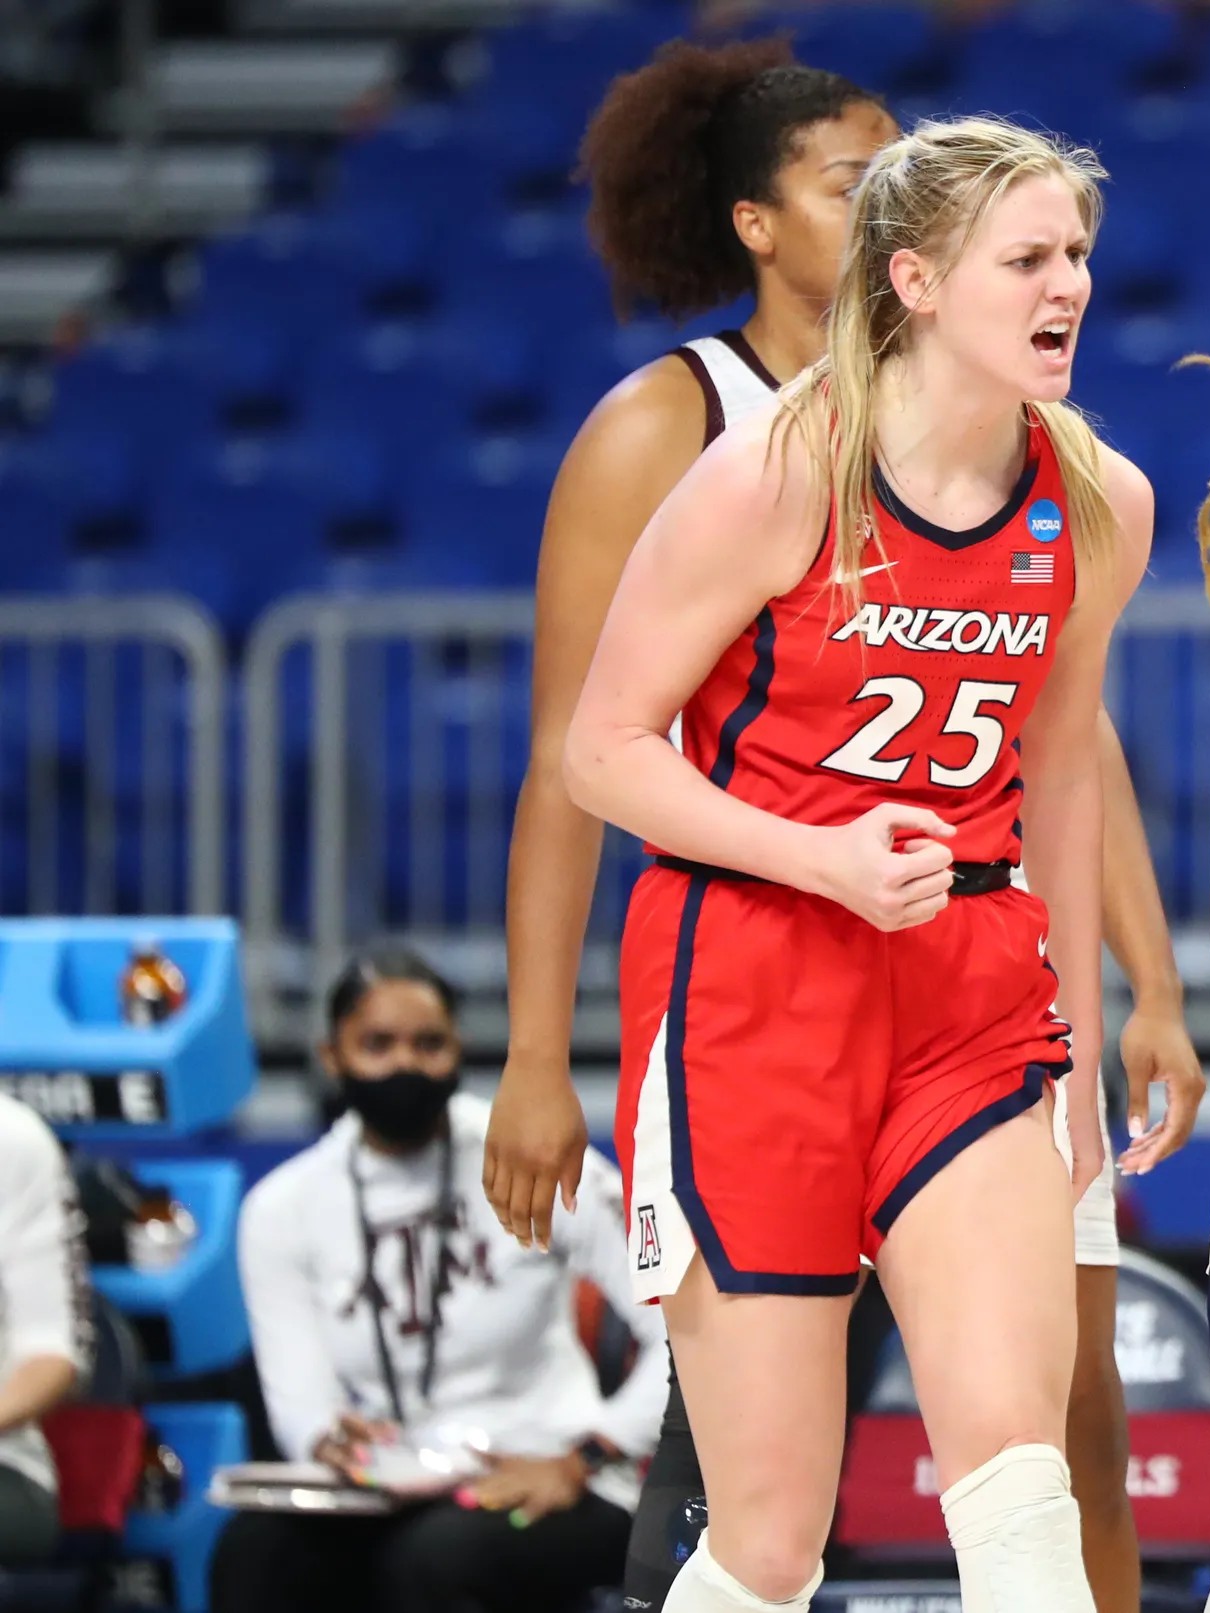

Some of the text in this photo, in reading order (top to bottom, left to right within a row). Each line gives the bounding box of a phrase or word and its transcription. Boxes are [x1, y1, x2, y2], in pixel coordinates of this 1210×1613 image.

[1031, 519, 1062, 531] NCAA
[829, 601, 1050, 657] ARIZONA
[816, 674, 1020, 789] 25
[637, 1204, 662, 1271] A
